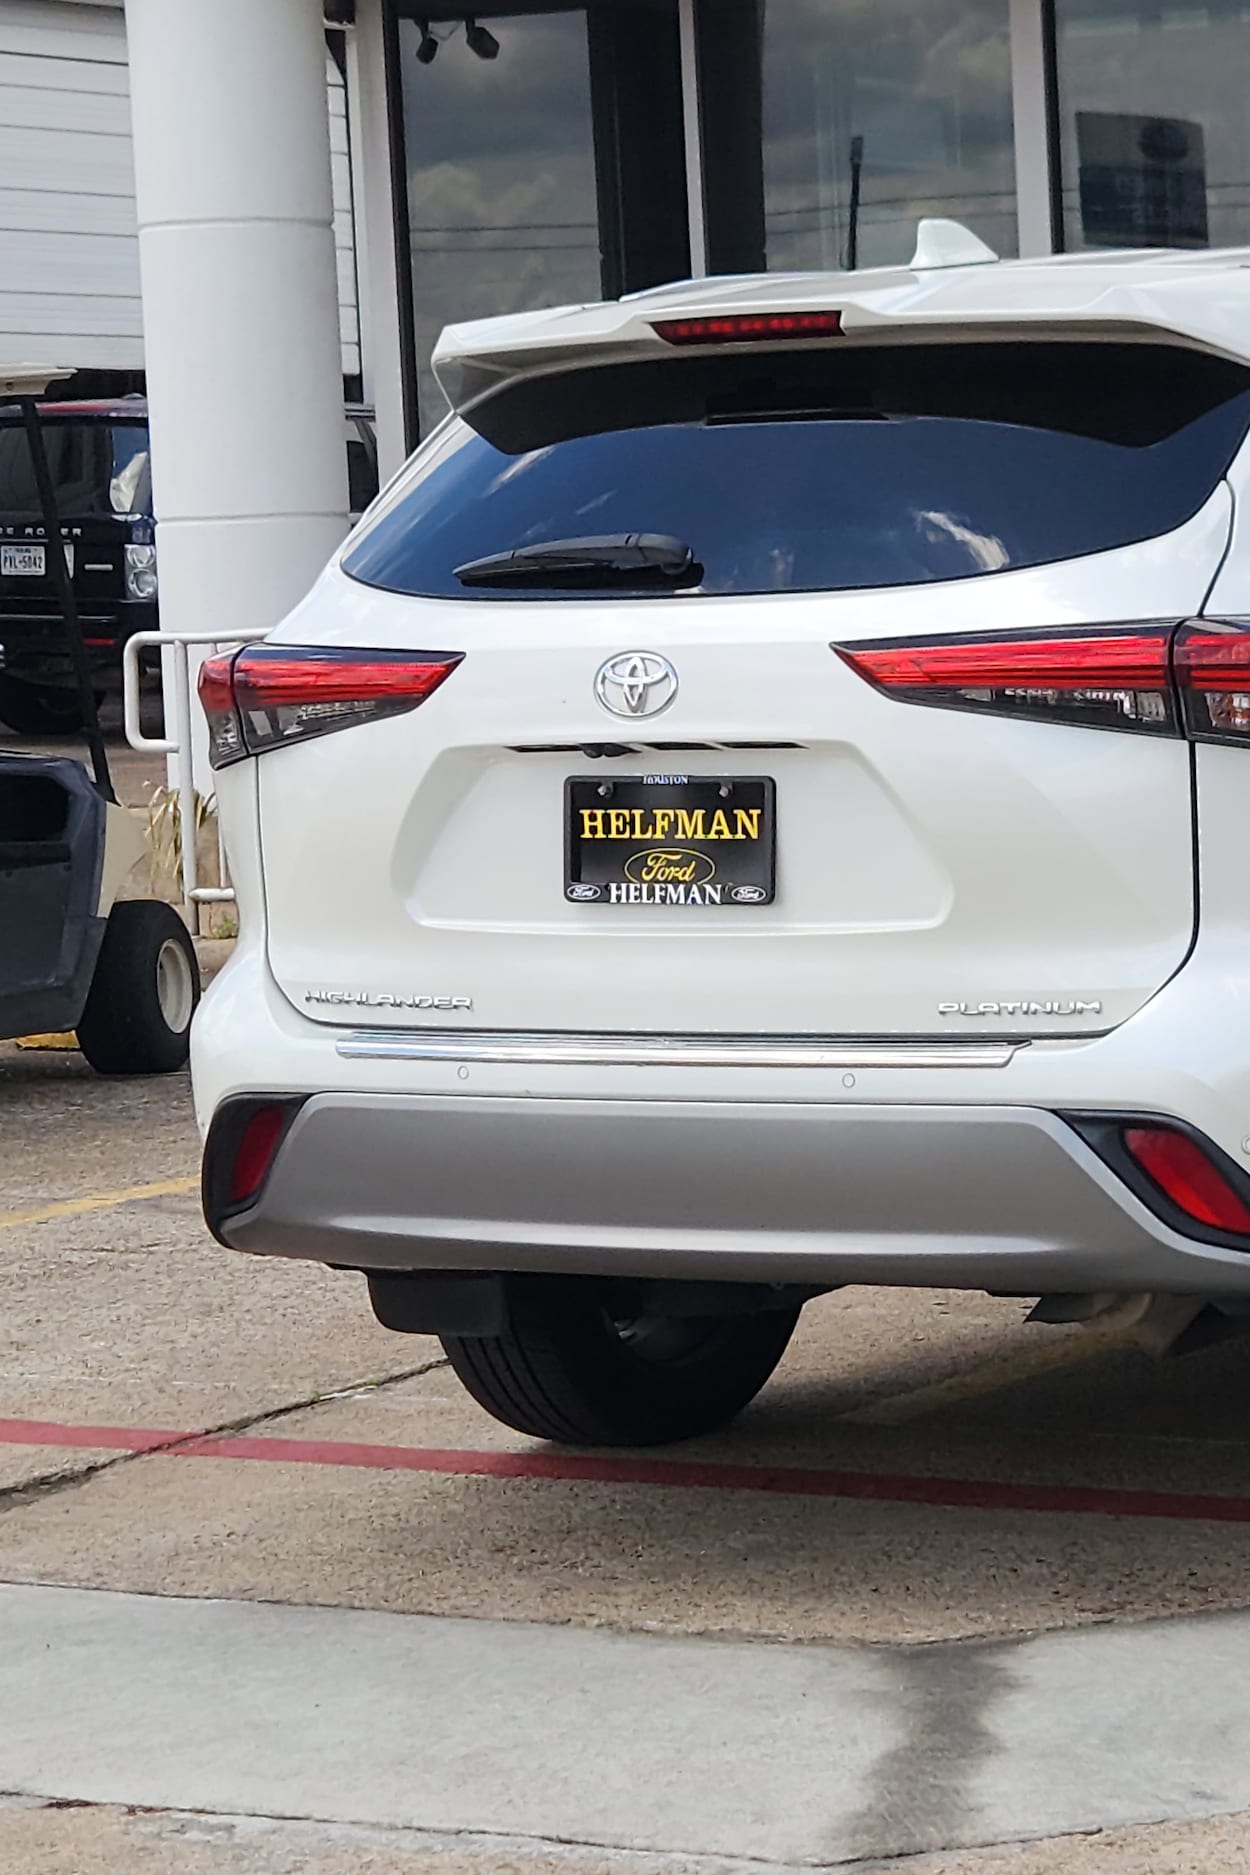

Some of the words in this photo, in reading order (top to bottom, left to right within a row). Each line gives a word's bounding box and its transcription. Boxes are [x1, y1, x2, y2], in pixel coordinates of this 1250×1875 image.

[24, 527, 82, 537] ROER
[579, 809, 761, 839] HELFMAN
[641, 852, 696, 882] Ford
[609, 882, 722, 904] HELFMAN
[305, 991, 473, 1010] HIGHLANDER
[938, 1001, 1101, 1015] PLATINUM
